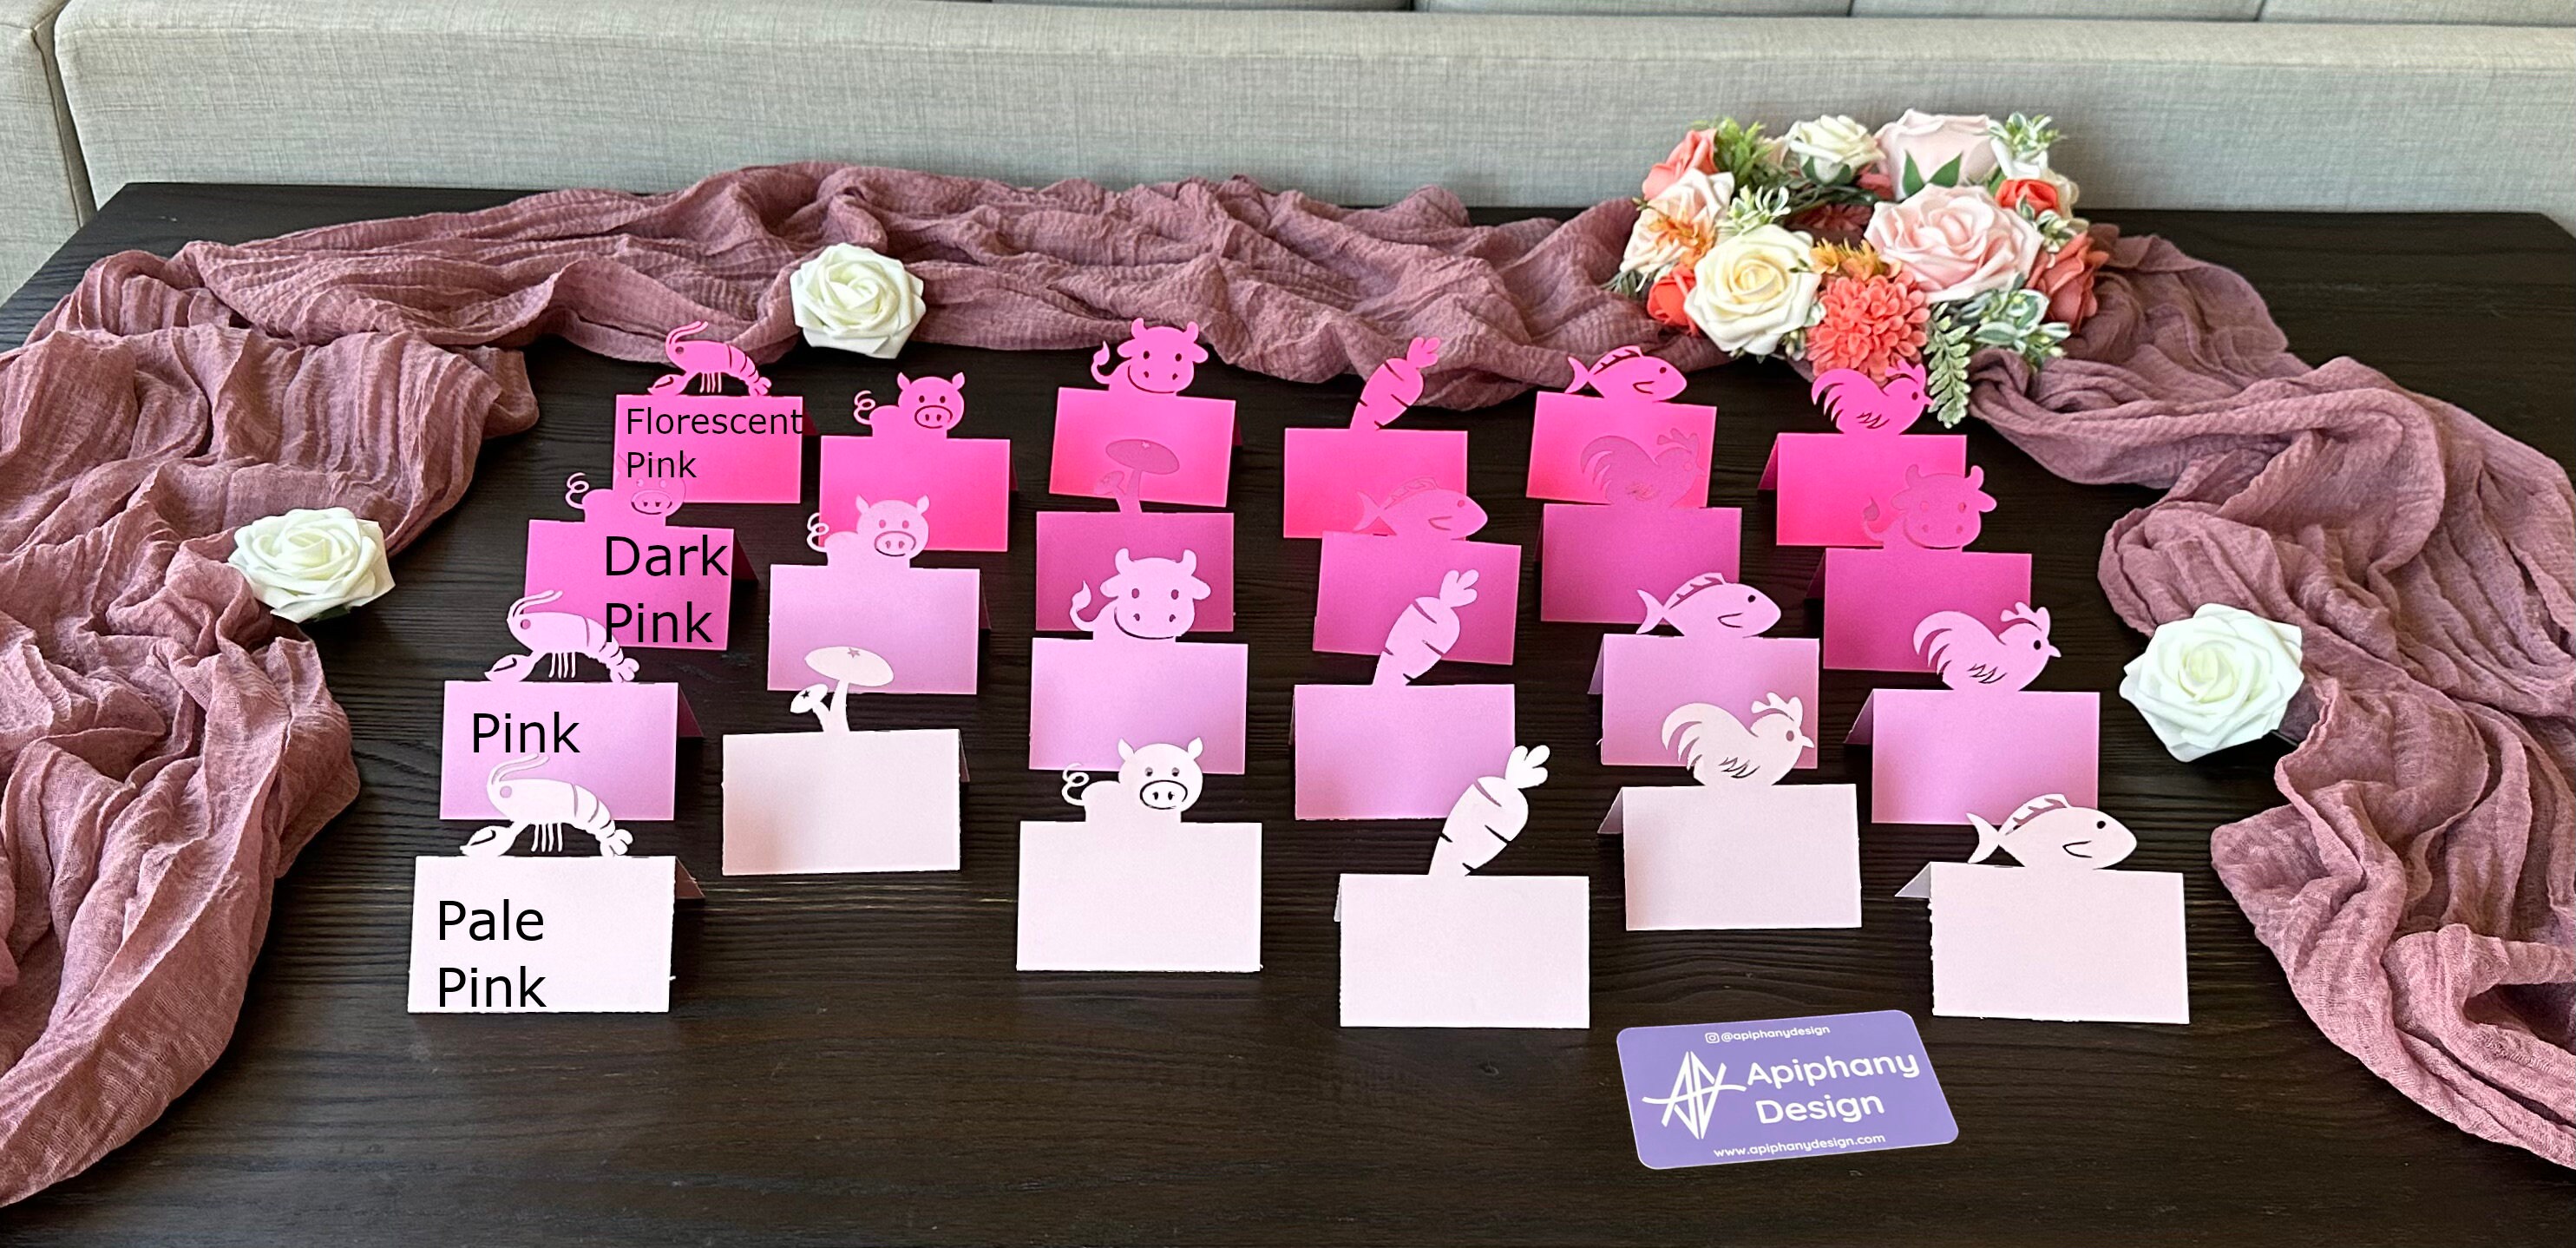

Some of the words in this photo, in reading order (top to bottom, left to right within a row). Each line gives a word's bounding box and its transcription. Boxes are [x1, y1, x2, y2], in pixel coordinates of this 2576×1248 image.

[1721, 1025, 1831, 1042] @apiphanydesign
[1747, 1054, 1920, 1089] Apiphany
[1755, 1094, 1884, 1124] Design
[1714, 1133, 1886, 1158] www.apiphanydesign.com
